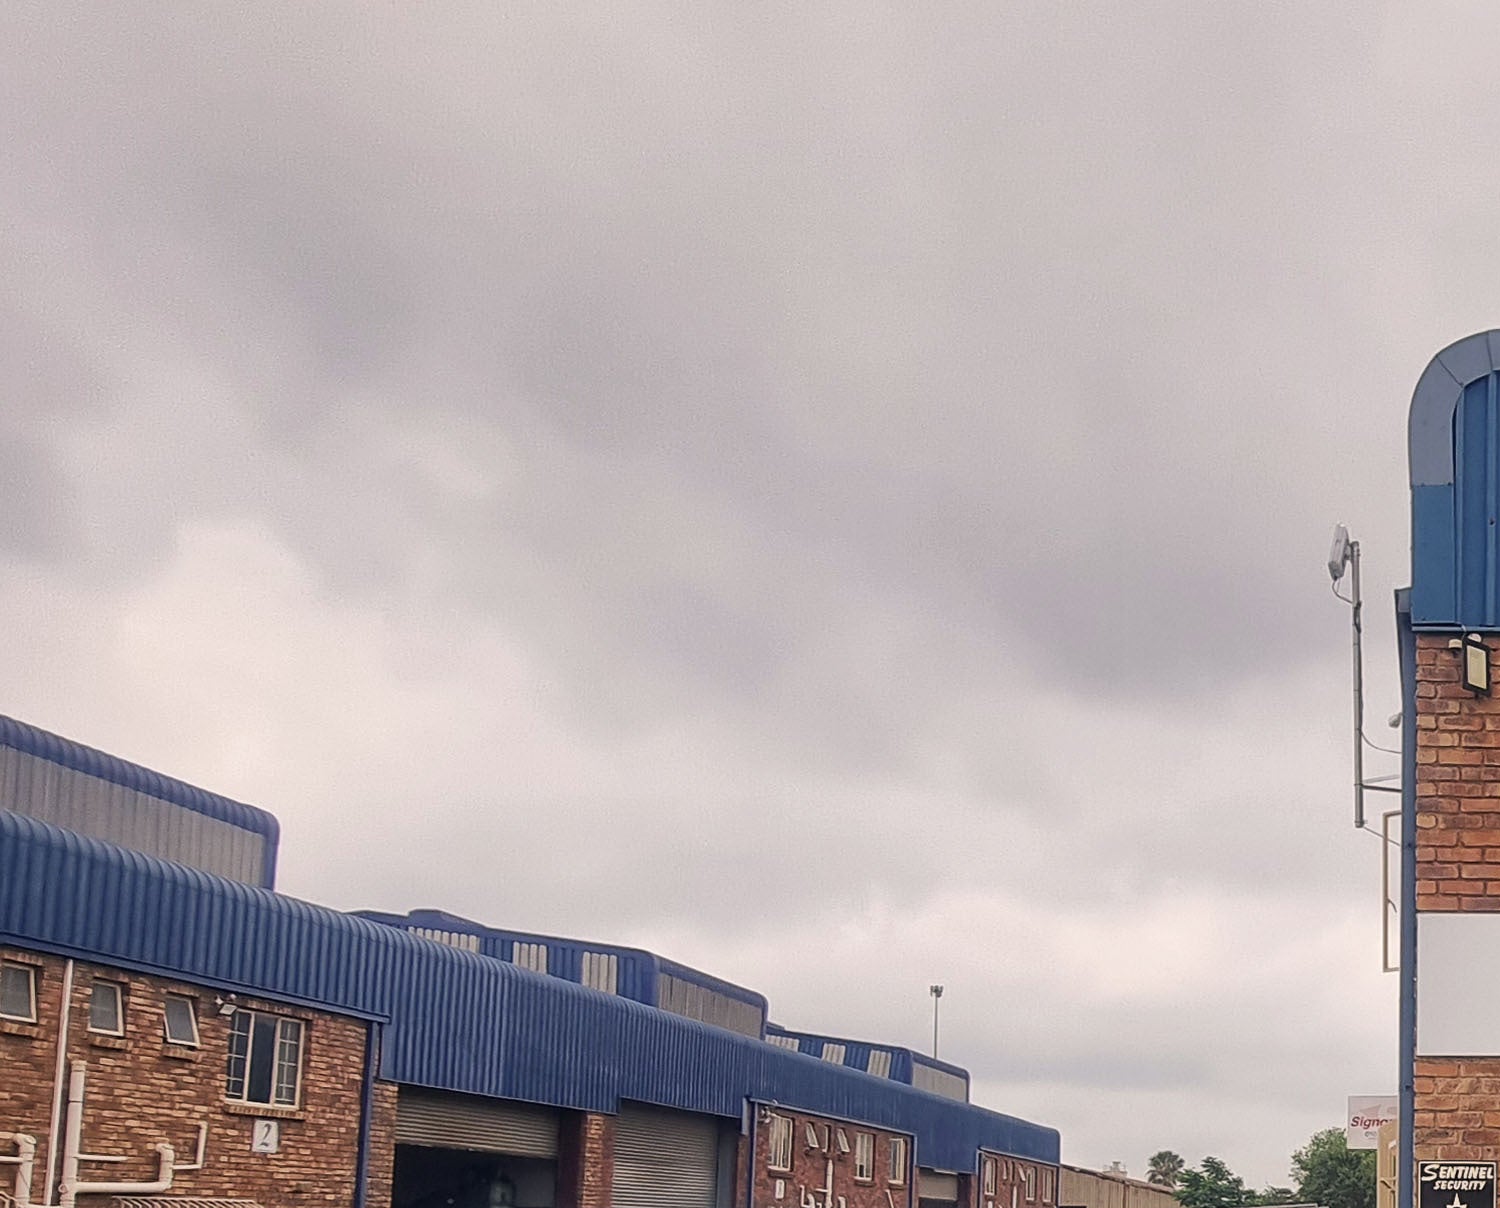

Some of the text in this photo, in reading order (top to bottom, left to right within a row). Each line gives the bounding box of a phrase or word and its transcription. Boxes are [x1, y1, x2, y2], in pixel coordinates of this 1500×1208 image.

[259, 1122, 272, 1148] 2
[1421, 1163, 1494, 1181] SENTINEL
[1433, 1180, 1486, 1191] SECURITY
